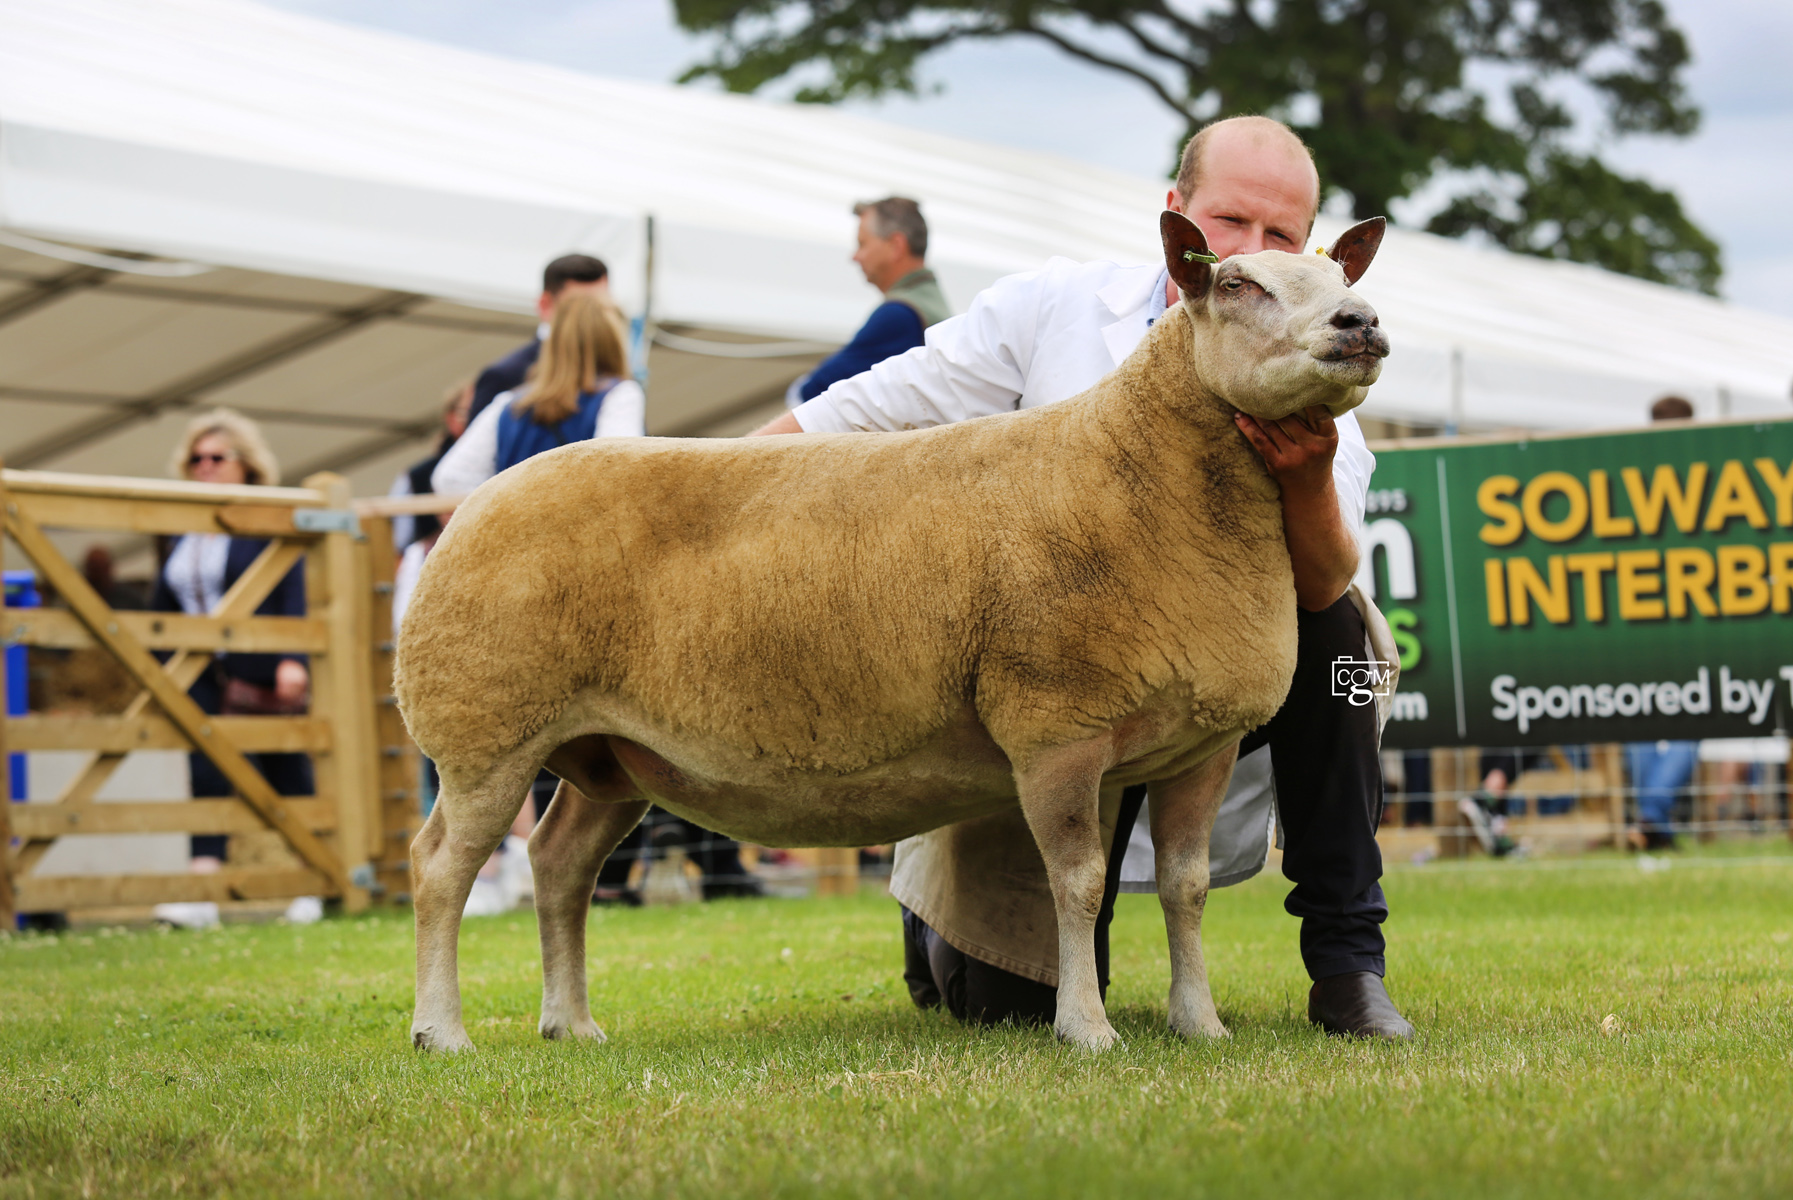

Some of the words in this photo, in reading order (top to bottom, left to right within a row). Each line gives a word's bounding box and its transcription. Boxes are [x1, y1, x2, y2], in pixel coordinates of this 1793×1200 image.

[1477, 457, 1793, 545] SOLWAY
[1490, 665, 1712, 734] Sponsored
[1719, 665, 1775, 725] by
